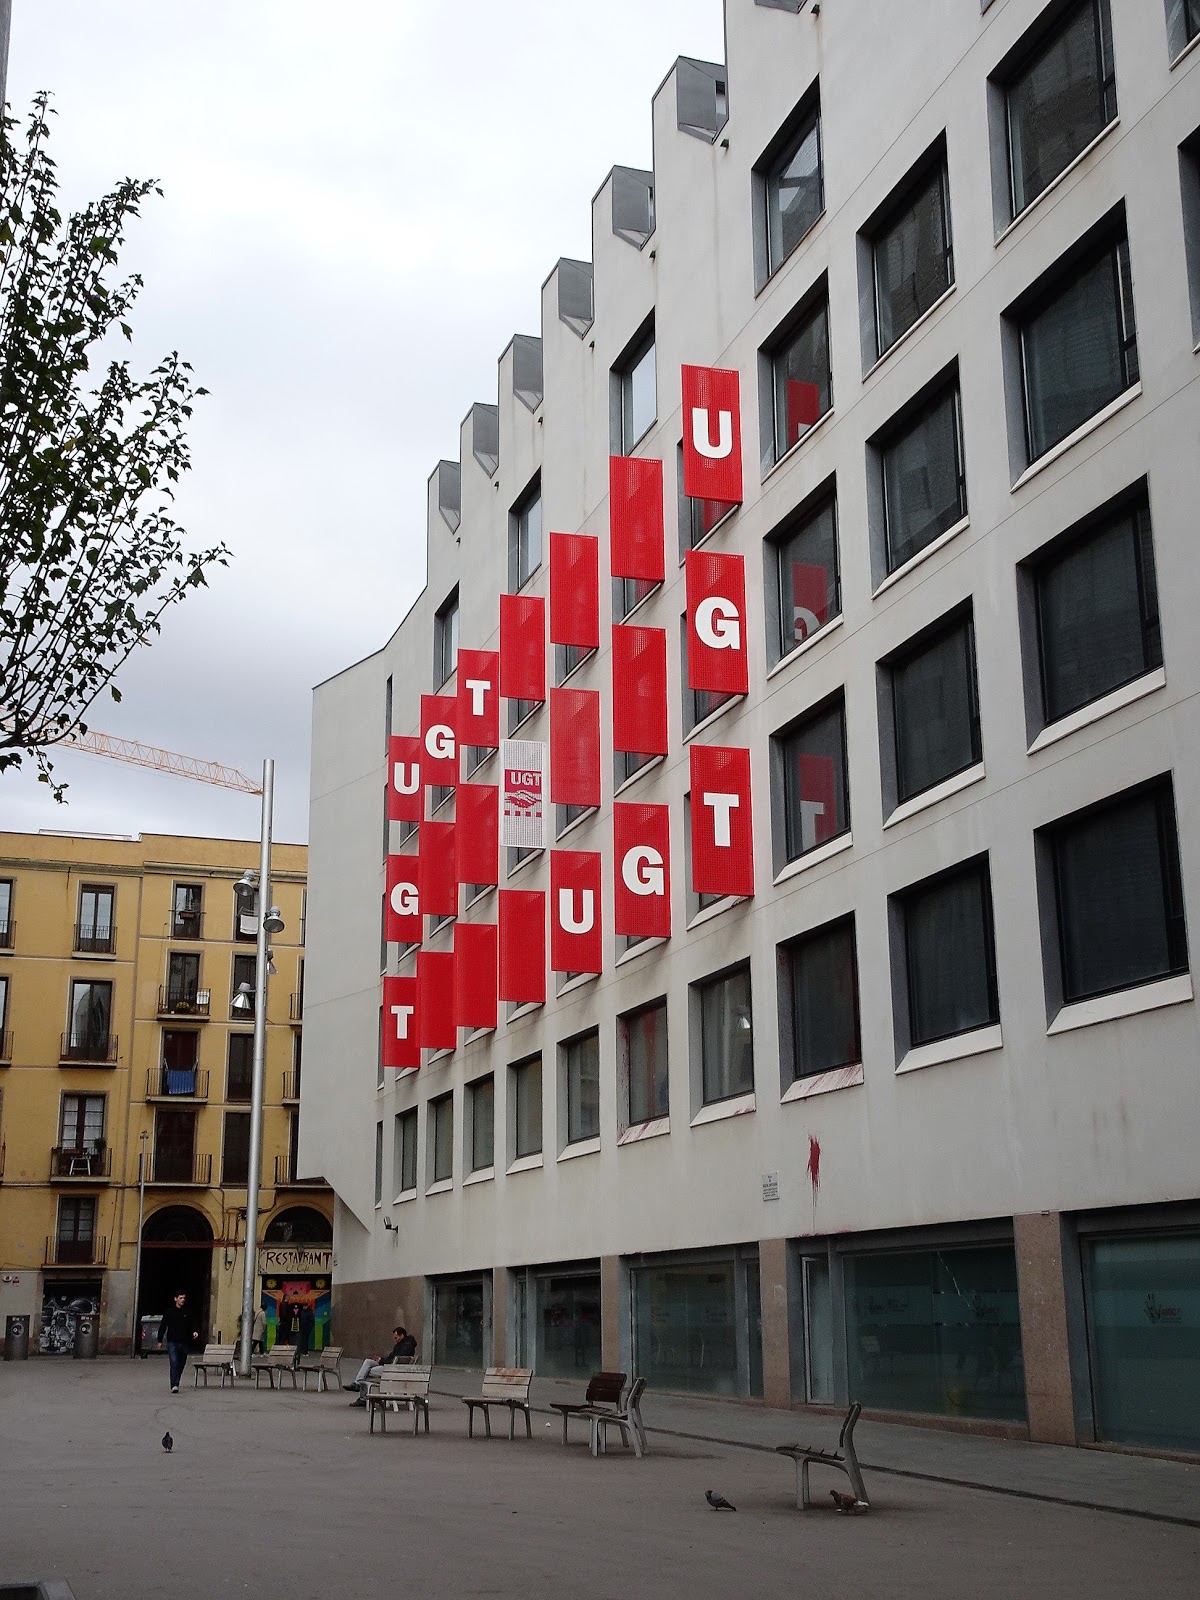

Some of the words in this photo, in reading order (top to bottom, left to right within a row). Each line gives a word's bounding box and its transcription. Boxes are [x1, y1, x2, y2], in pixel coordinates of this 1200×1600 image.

[692, 408, 733, 458] U
[695, 597, 740, 649] G
[466, 680, 490, 715] T
[425, 725, 455, 759] G
[394, 762, 419, 794] U
[511, 771, 541, 786] UGT
[704, 793, 739, 846] T
[622, 846, 664, 895] G
[391, 883, 418, 915] G
[559, 889, 593, 933] U
[391, 1005, 413, 1038] T
